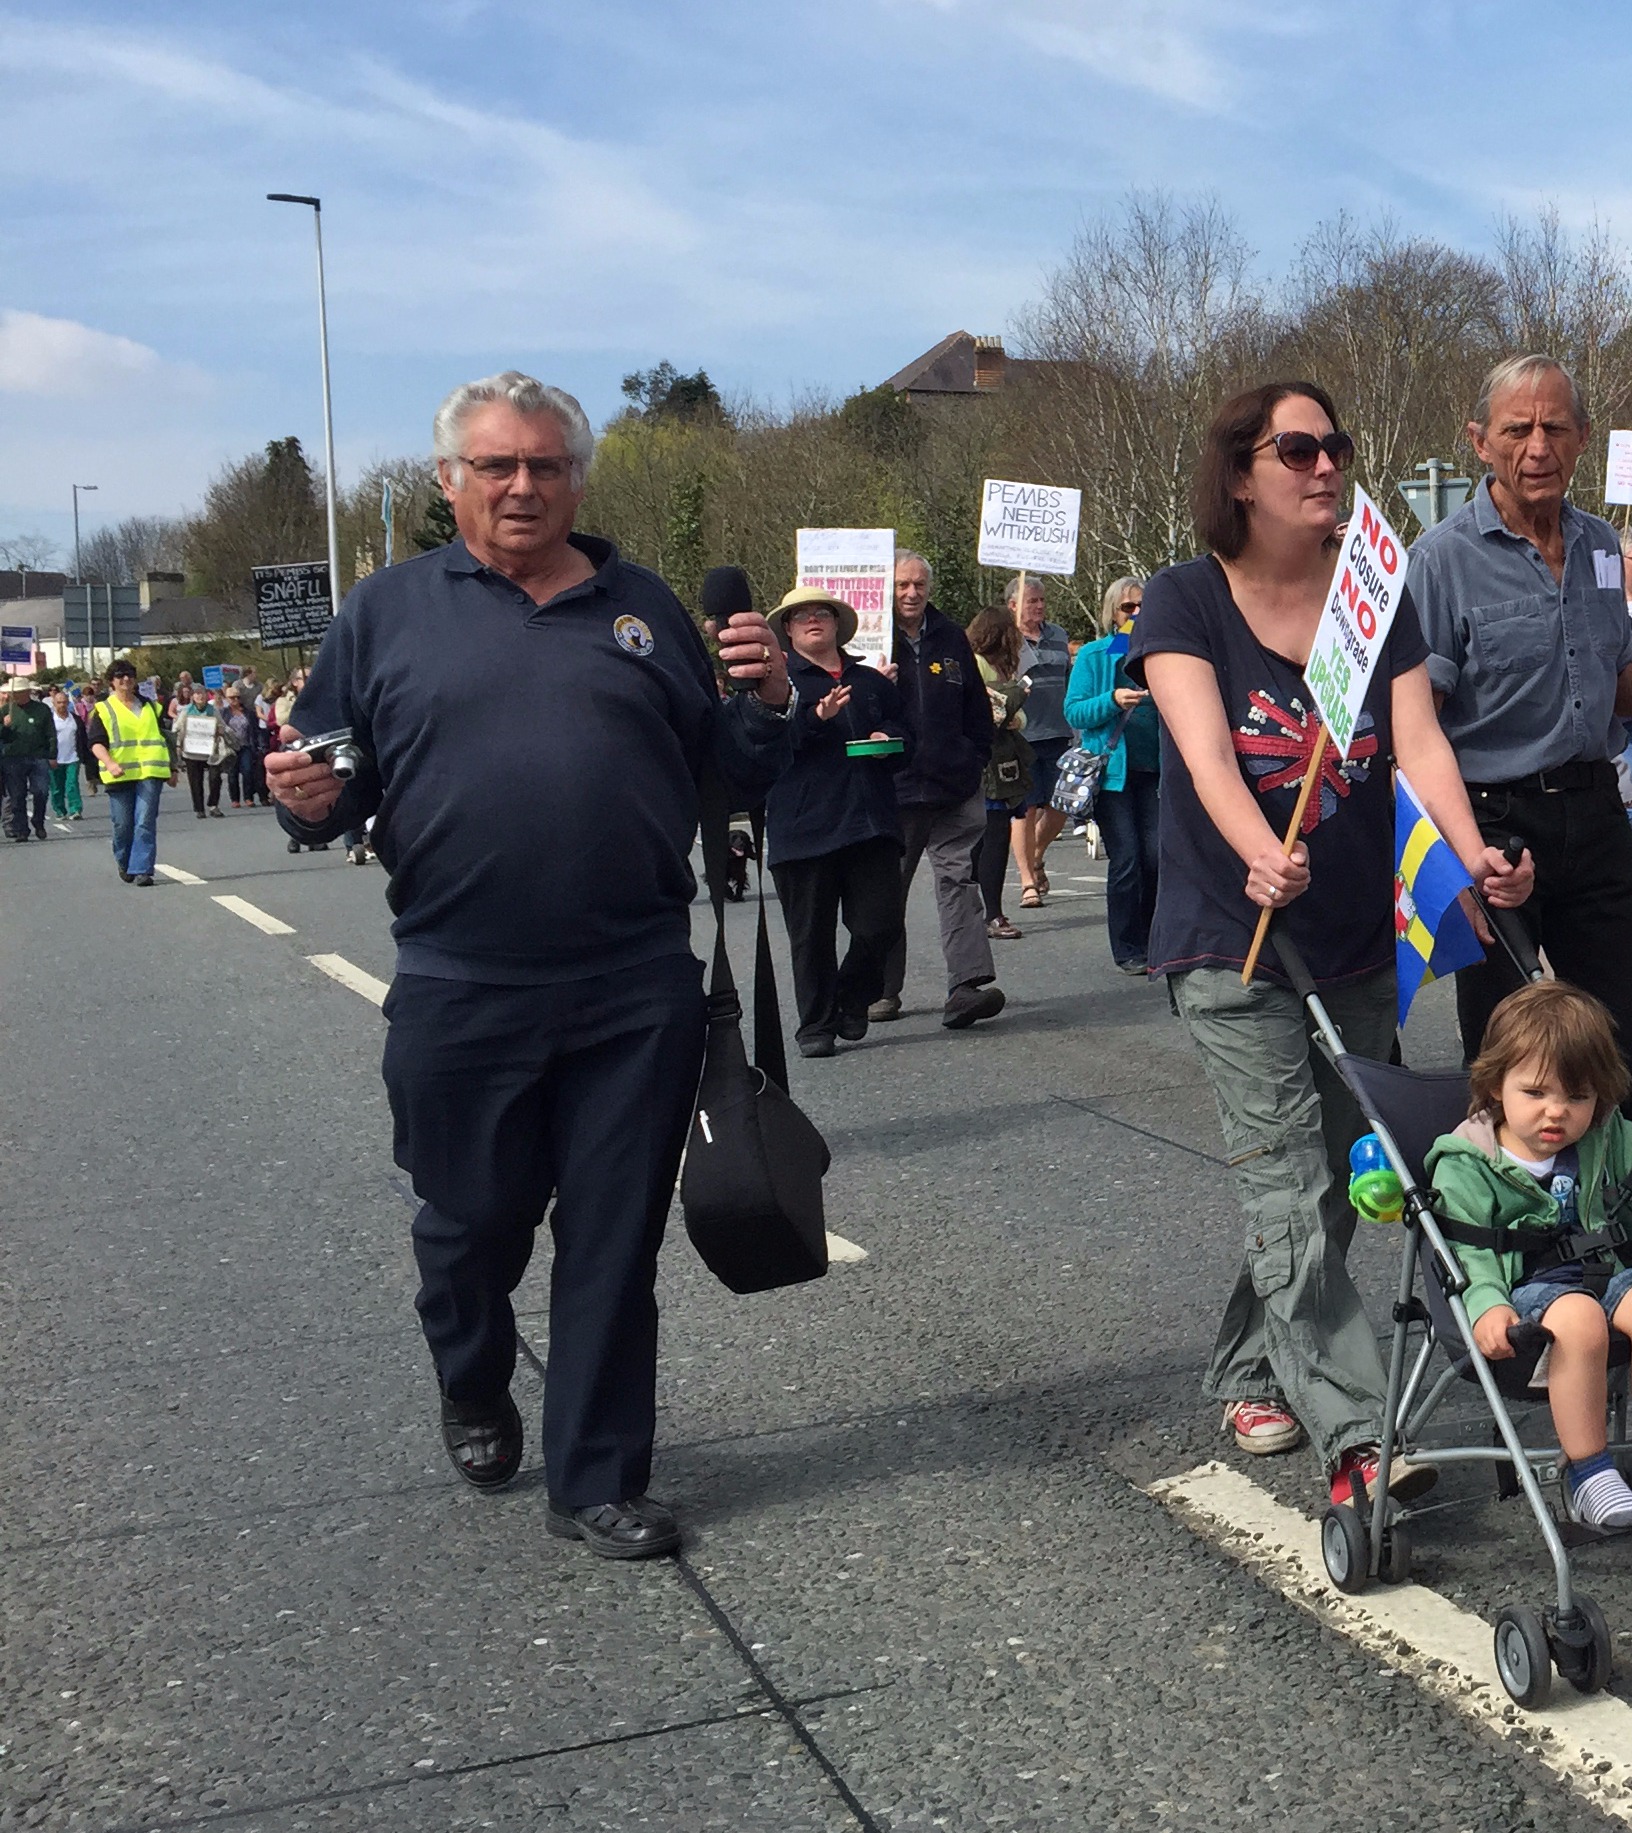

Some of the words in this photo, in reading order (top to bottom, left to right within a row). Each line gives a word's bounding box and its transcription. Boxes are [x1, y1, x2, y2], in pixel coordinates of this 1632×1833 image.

[988, 482, 1063, 508] PEMBS
[1002, 506, 1066, 526] NEEDS
[983, 519, 1076, 544] WITHYBUSH!
[1361, 503, 1398, 575] NO
[260, 579, 321, 602] SNAFU
[1340, 566, 1376, 640] NO
[1350, 533, 1389, 613] Closure
[1331, 591, 1369, 674] Downgrade
[1309, 649, 1353, 749] UPGRADE
[1330, 637, 1351, 696] YES
